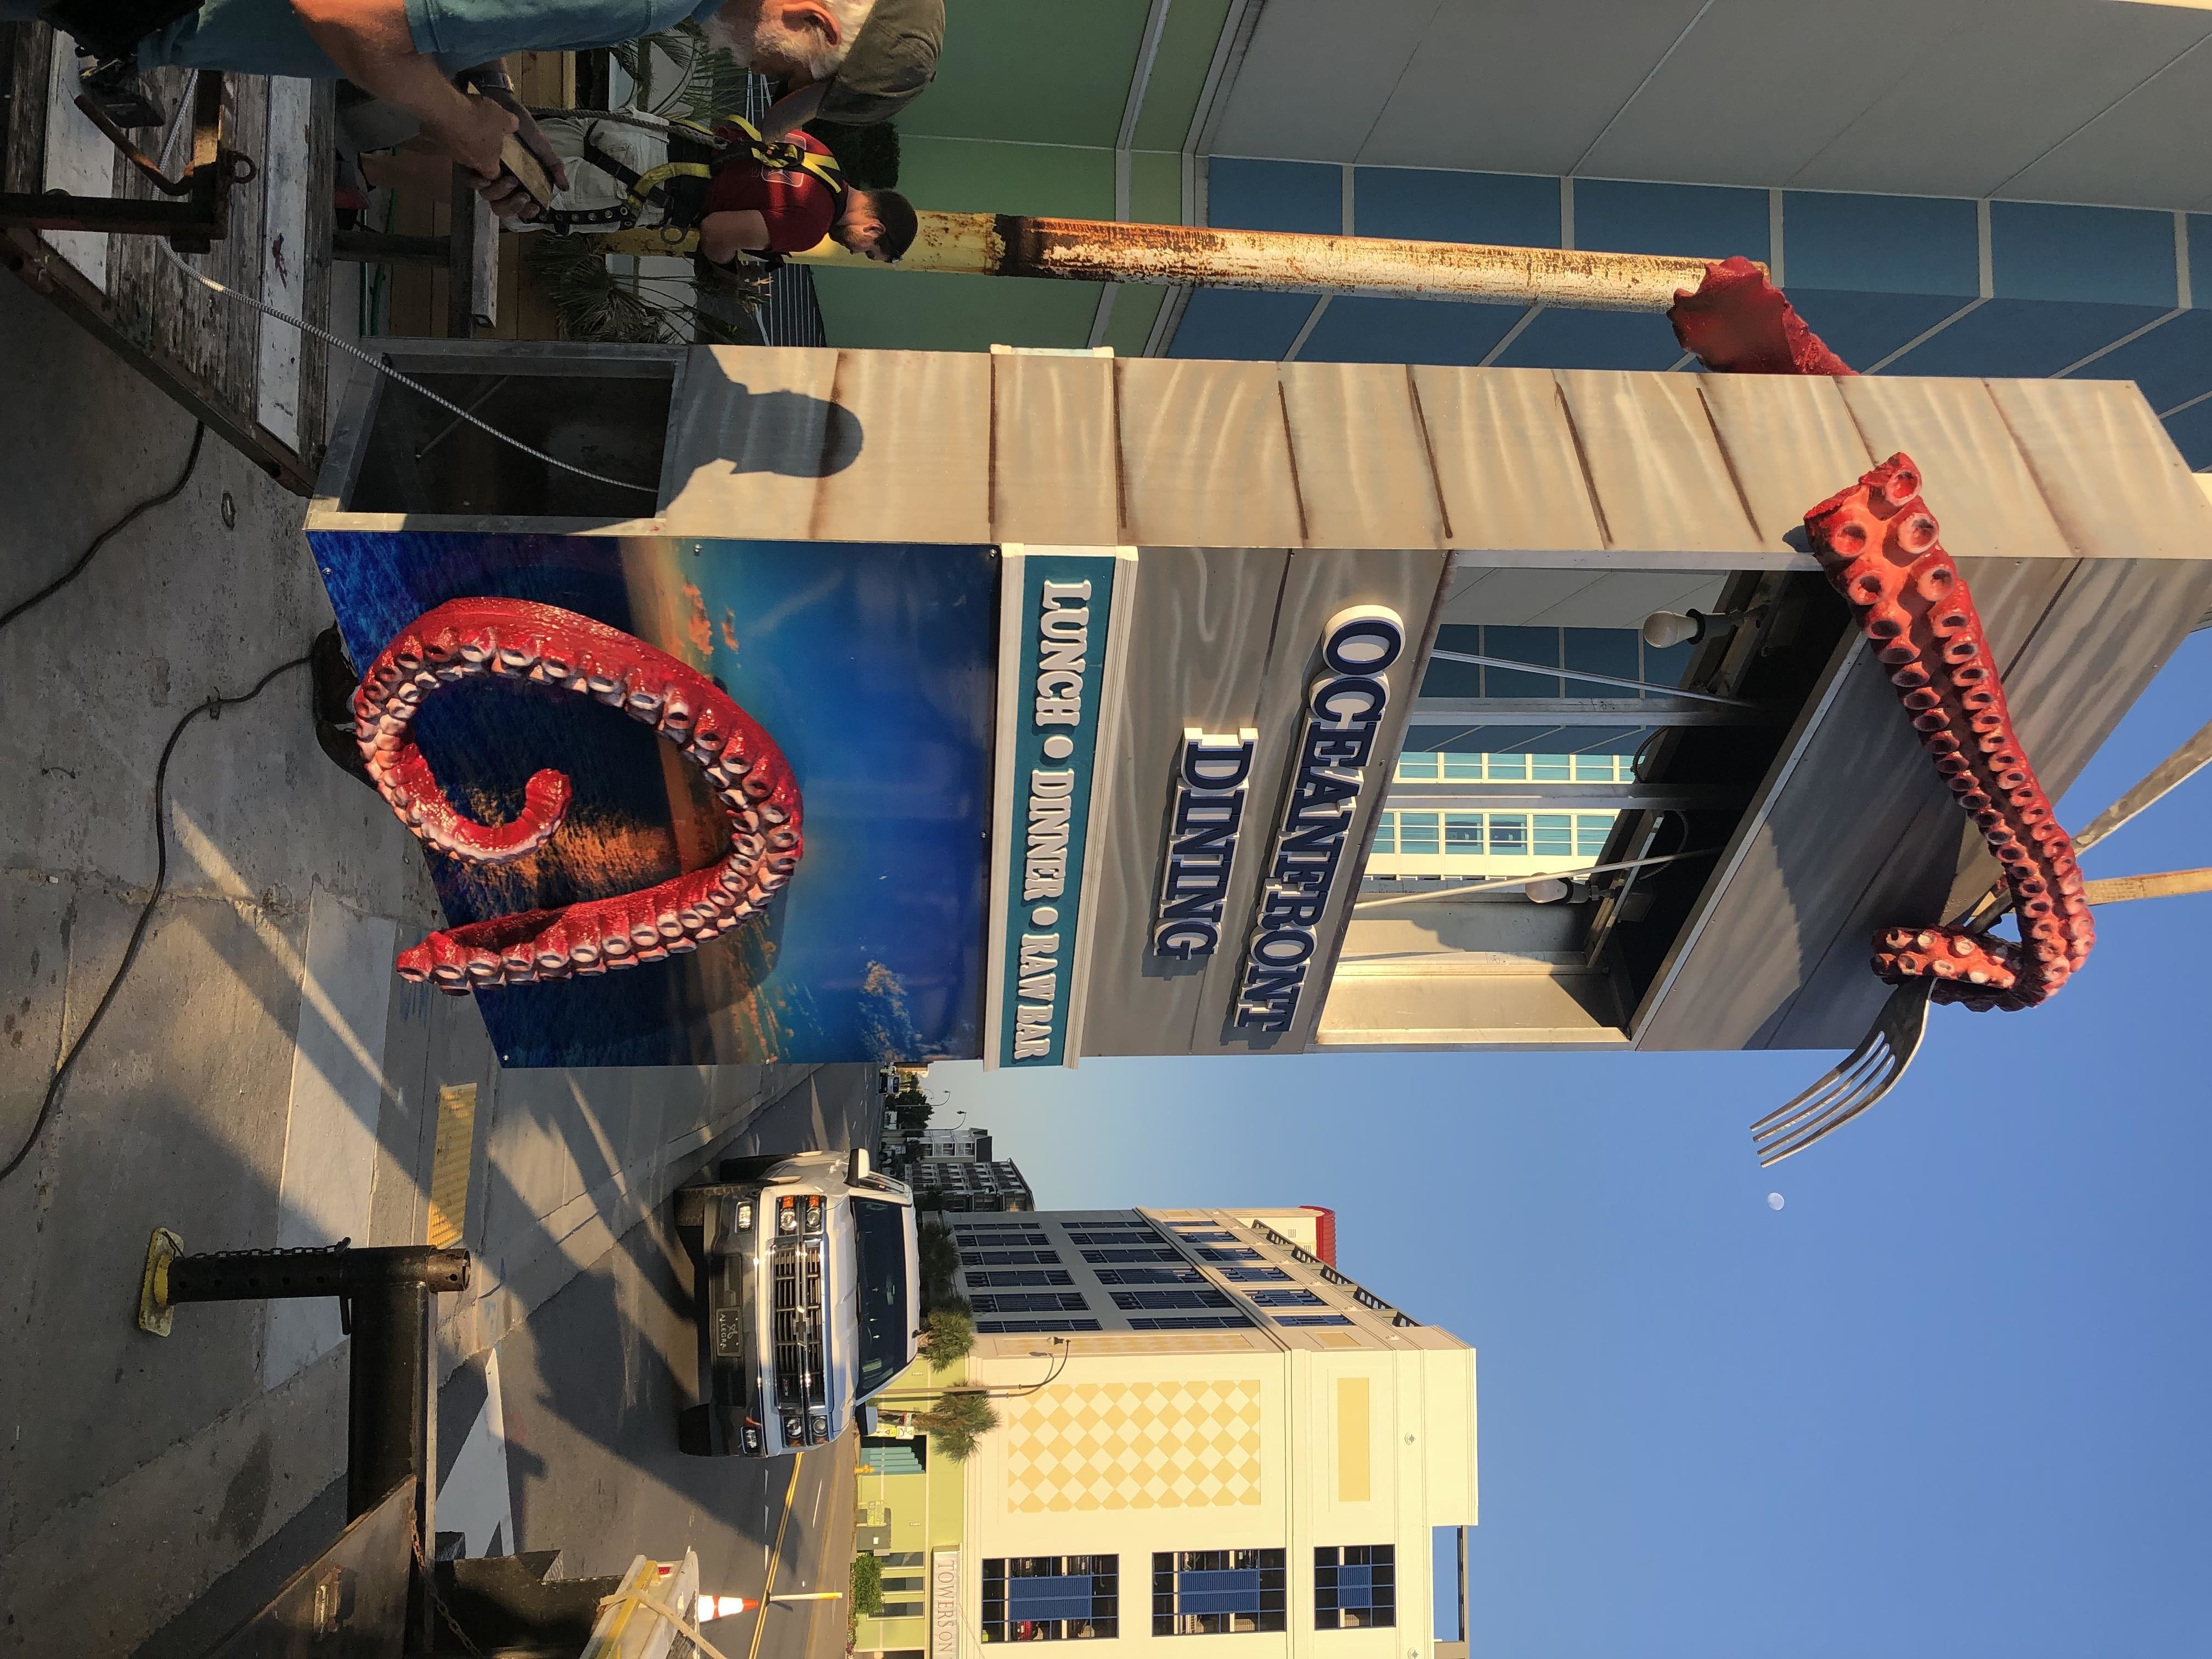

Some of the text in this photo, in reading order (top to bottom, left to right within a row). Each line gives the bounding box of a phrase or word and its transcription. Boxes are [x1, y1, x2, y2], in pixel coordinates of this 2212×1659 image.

[1013, 580, 1092, 1059] LUNCH DINNER RAW BAR
[1153, 727, 1259, 960] DINING
[1233, 605, 1406, 1032] OCEANFRONT
[938, 1560, 954, 1628] TOWERS
[939, 1632, 953, 1652] ON
